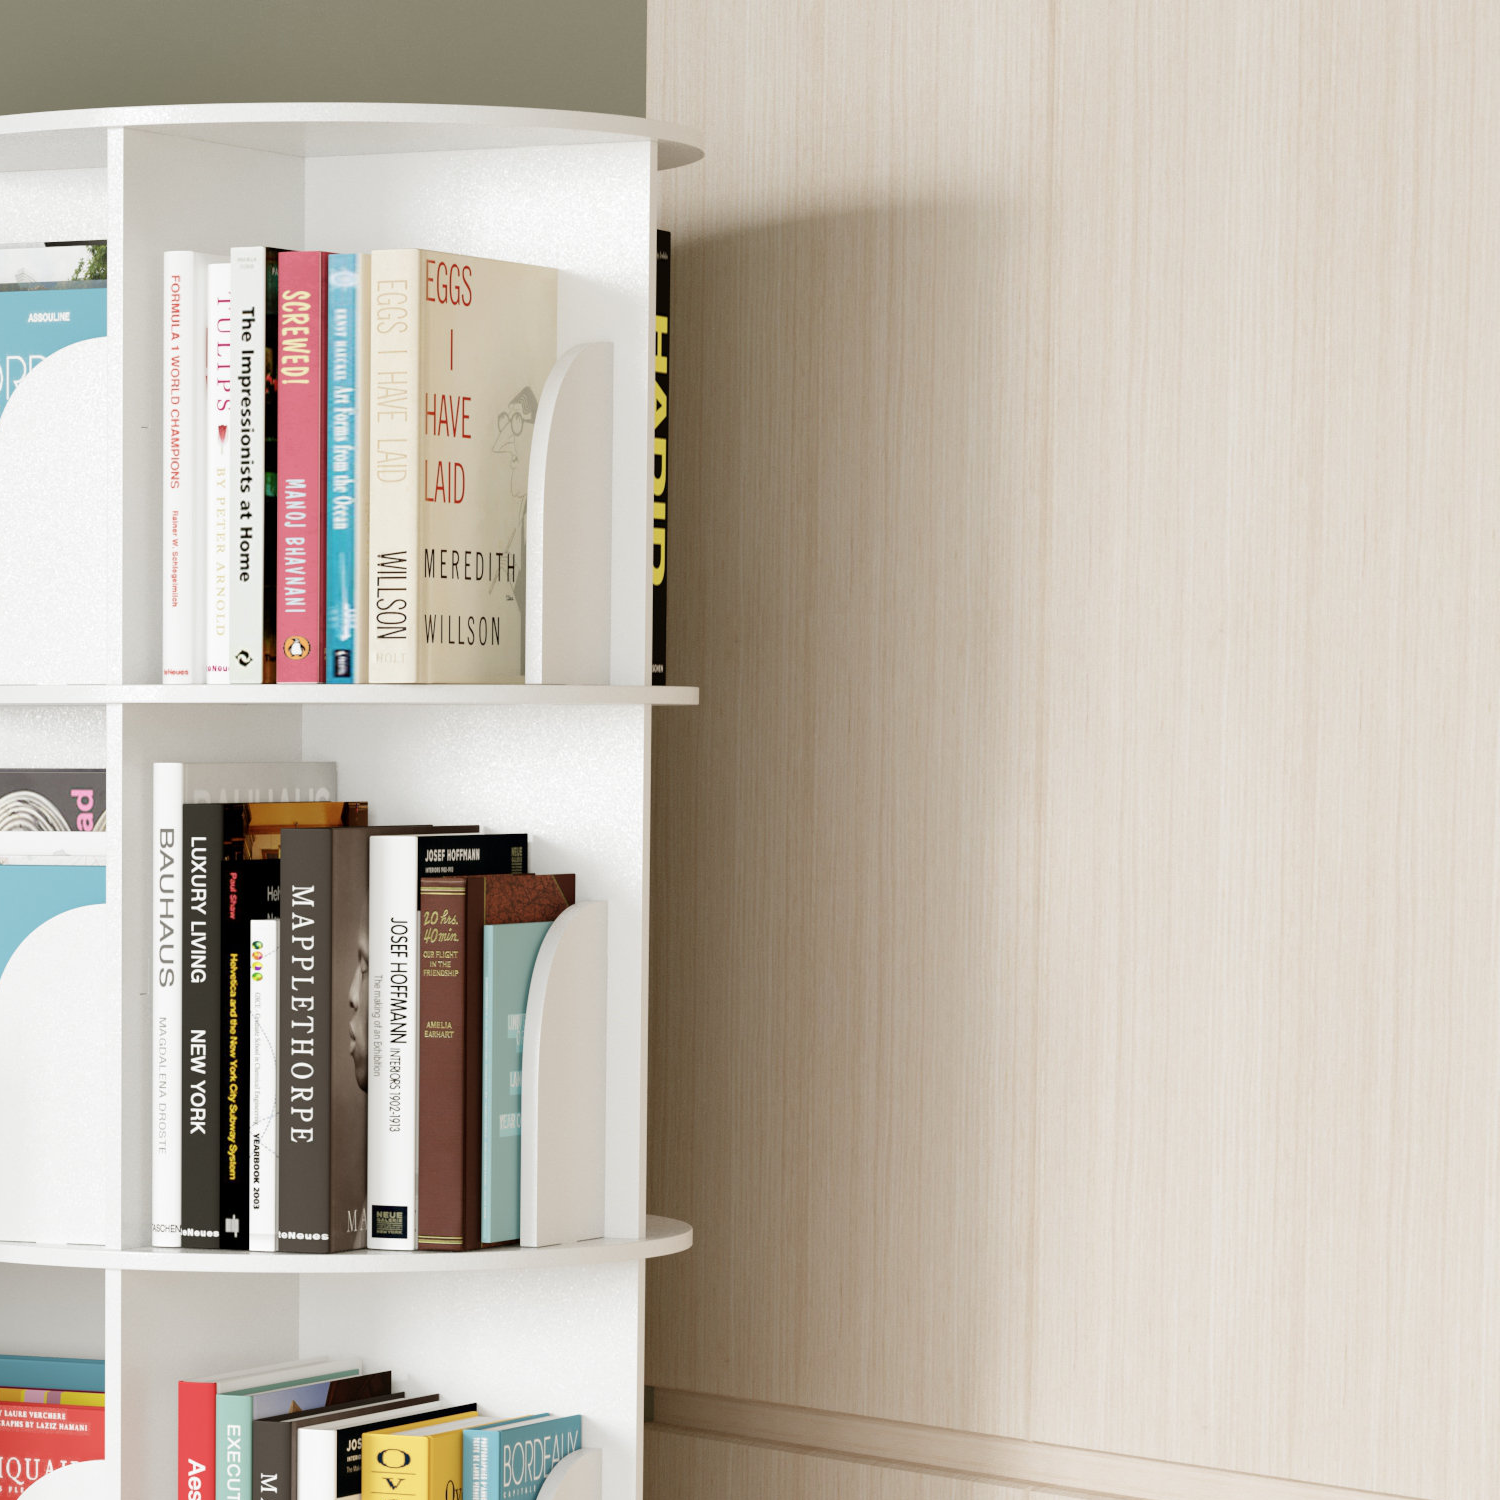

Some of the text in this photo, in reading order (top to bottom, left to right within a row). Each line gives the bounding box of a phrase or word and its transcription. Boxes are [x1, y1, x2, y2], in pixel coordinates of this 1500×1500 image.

[426, 260, 472, 308] EGGS
[28, 312, 70, 322] ASSOULINE
[170, 275, 180, 340] FORMULA
[280, 290, 311, 385] SCREWED!
[170, 356, 180, 405] WORLD
[425, 394, 472, 439] HAVE
[170, 408, 180, 489] CHAMPIONS
[238, 307, 254, 582] The Impressionists at Home
[425, 460, 466, 504] LAID
[284, 478, 306, 613] MANOJ BHAVNANI
[424, 548, 516, 584] MEREDITH
[376, 550, 407, 640] WILLSON
[424, 614, 501, 647] WILLSON
[159, 828, 174, 988] BAUHAUS
[190, 836, 208, 984] LUXURY LIVING
[423, 911, 438, 926] 20
[423, 950, 459, 959] OUR FLIGHT
[424, 929, 438, 944] 40
[423, 968, 459, 977] FRIENDSHIP
[430, 960, 452, 968] IN THE
[291, 884, 314, 1143] MAPPLETHORPE
[424, 1031, 456, 1039] EARHART
[426, 1021, 452, 1030] AMELIA
[190, 1030, 206, 1135] NEW YORK
[227, 953, 238, 1180] Helvetica and the New York City Subway System
[36, 1422, 57, 1430] LAZIZ
[58, 1424, 88, 1432] HAMANI
